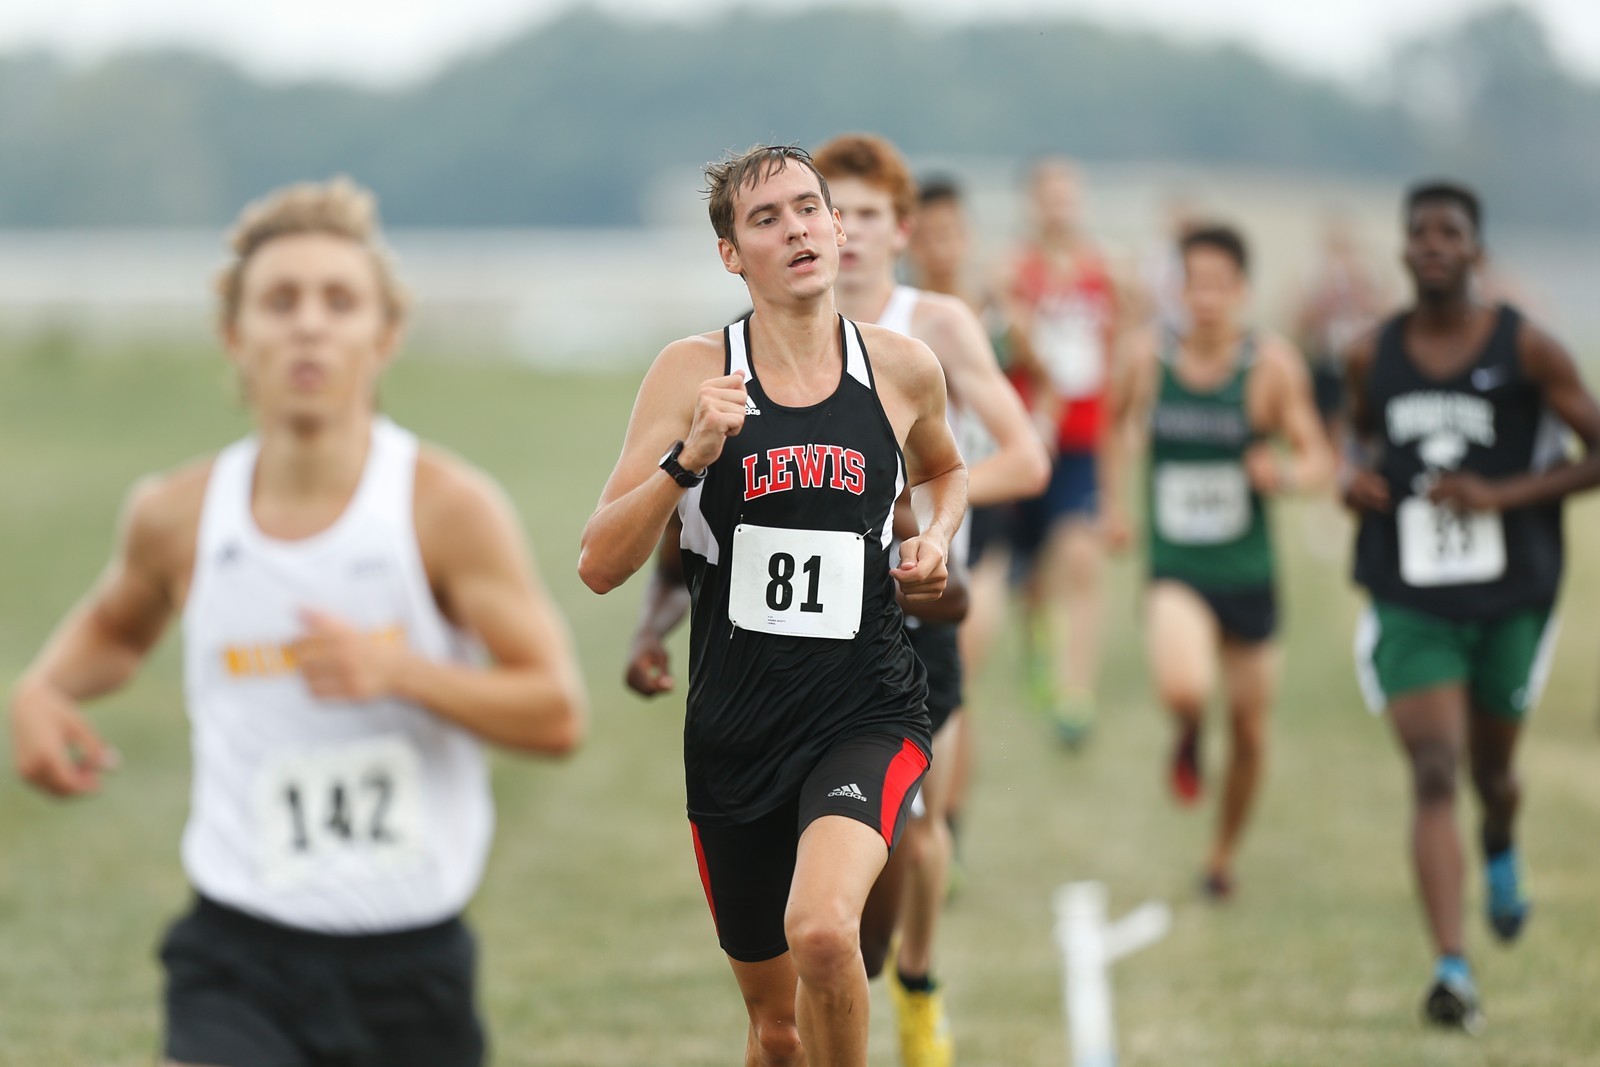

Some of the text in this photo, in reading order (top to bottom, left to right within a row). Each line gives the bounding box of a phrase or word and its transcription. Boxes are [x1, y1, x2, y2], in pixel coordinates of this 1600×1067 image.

[743, 443, 865, 501] LEWIS
[766, 552, 823, 613] 81
[284, 768, 403, 851] 142
[828, 790, 867, 802] adidas
